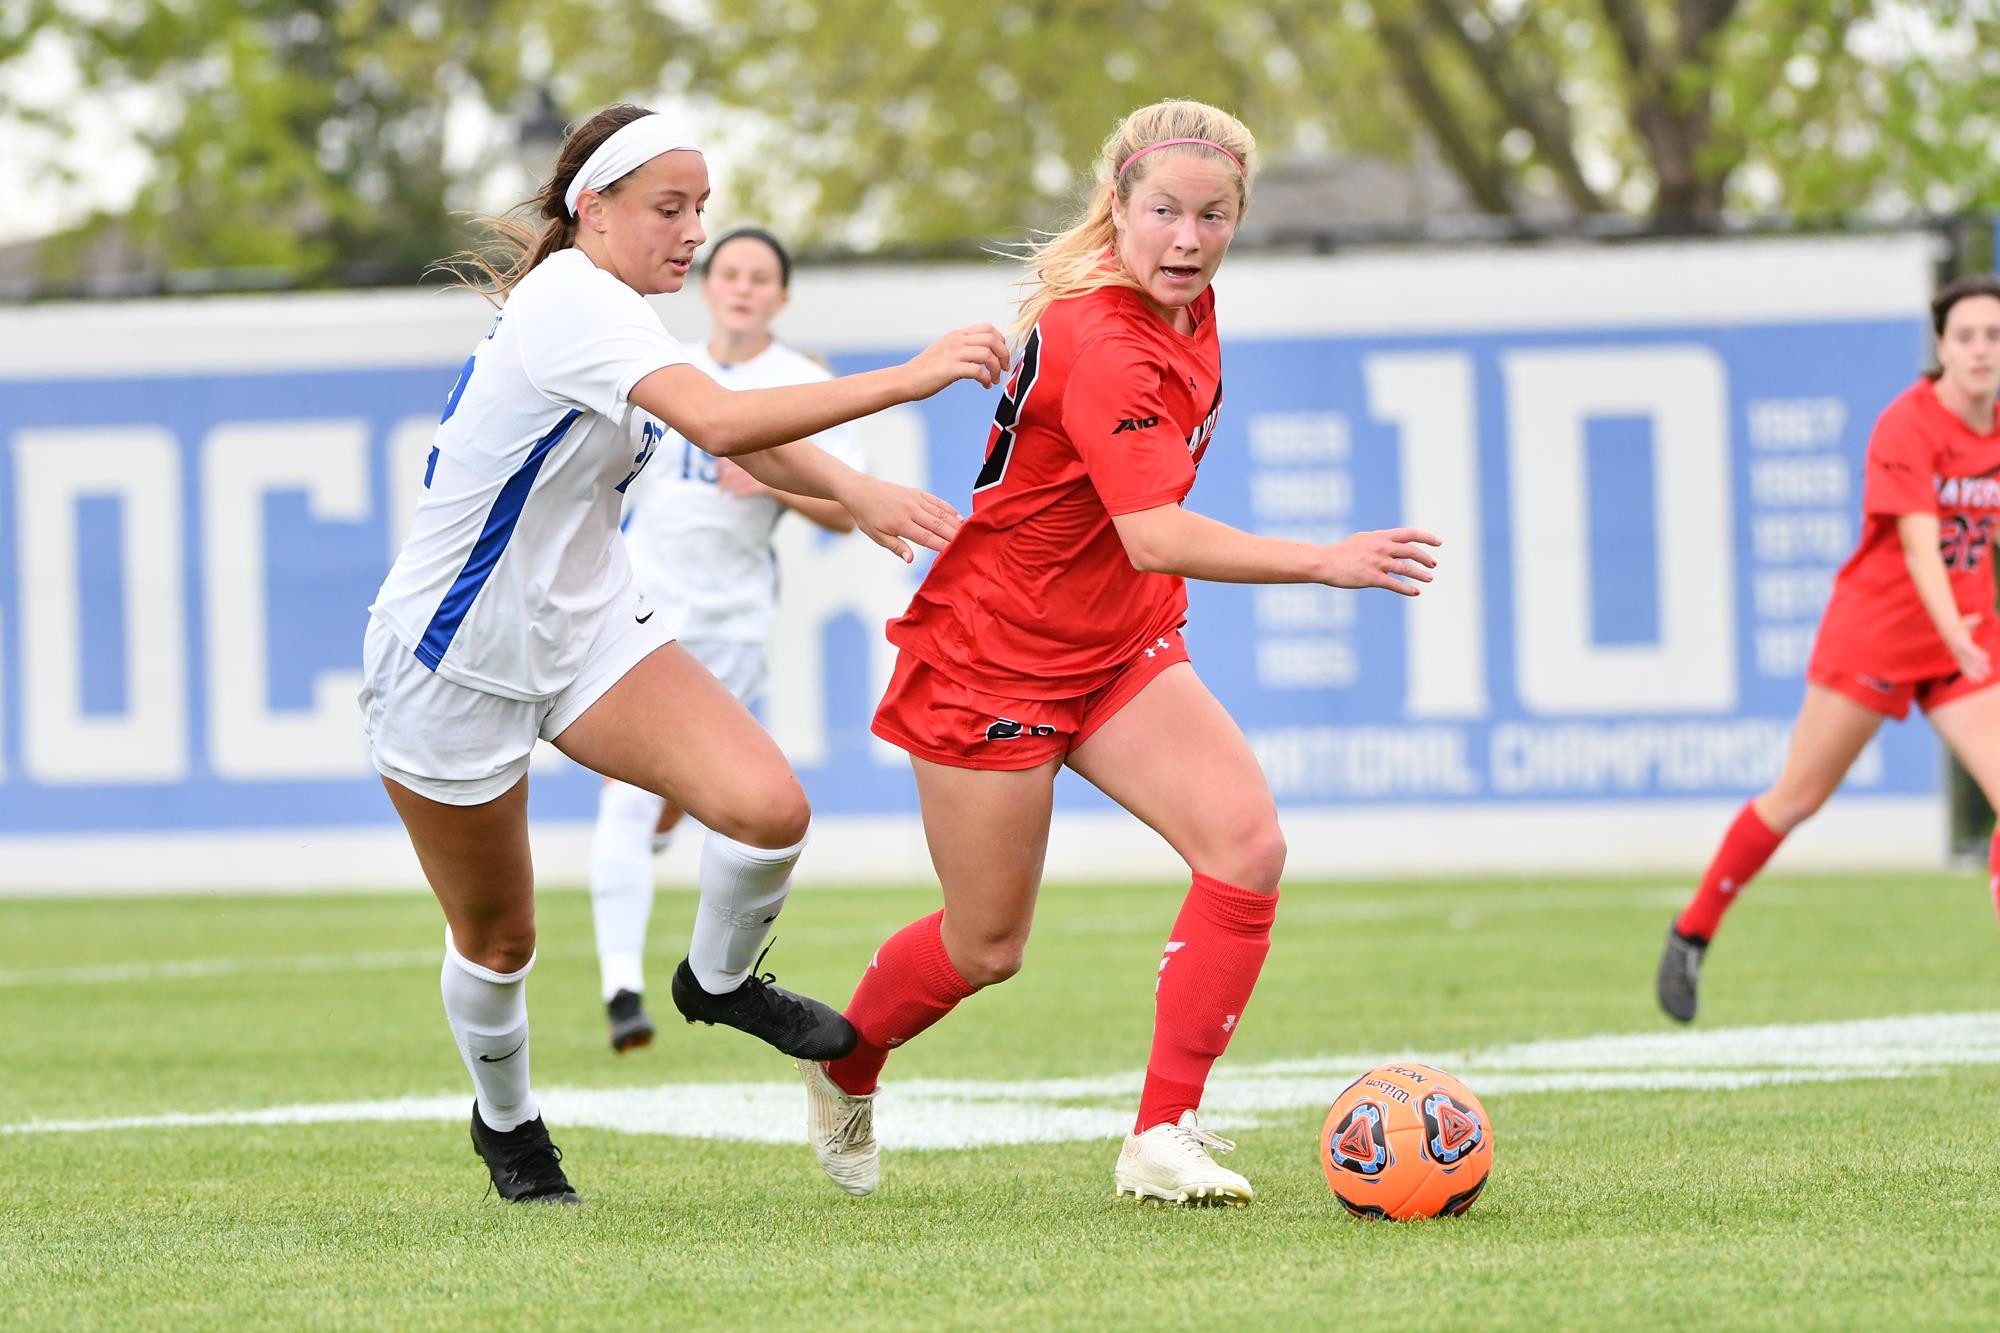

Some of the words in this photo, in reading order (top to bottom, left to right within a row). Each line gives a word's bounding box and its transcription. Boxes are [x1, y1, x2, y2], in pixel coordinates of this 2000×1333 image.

[1111, 416, 1159, 435] A10
[1364, 345, 1736, 720] 10
[1491, 720, 1884, 793] CHAMPIONSS
[1365, 1079, 1410, 1104] Wilson
